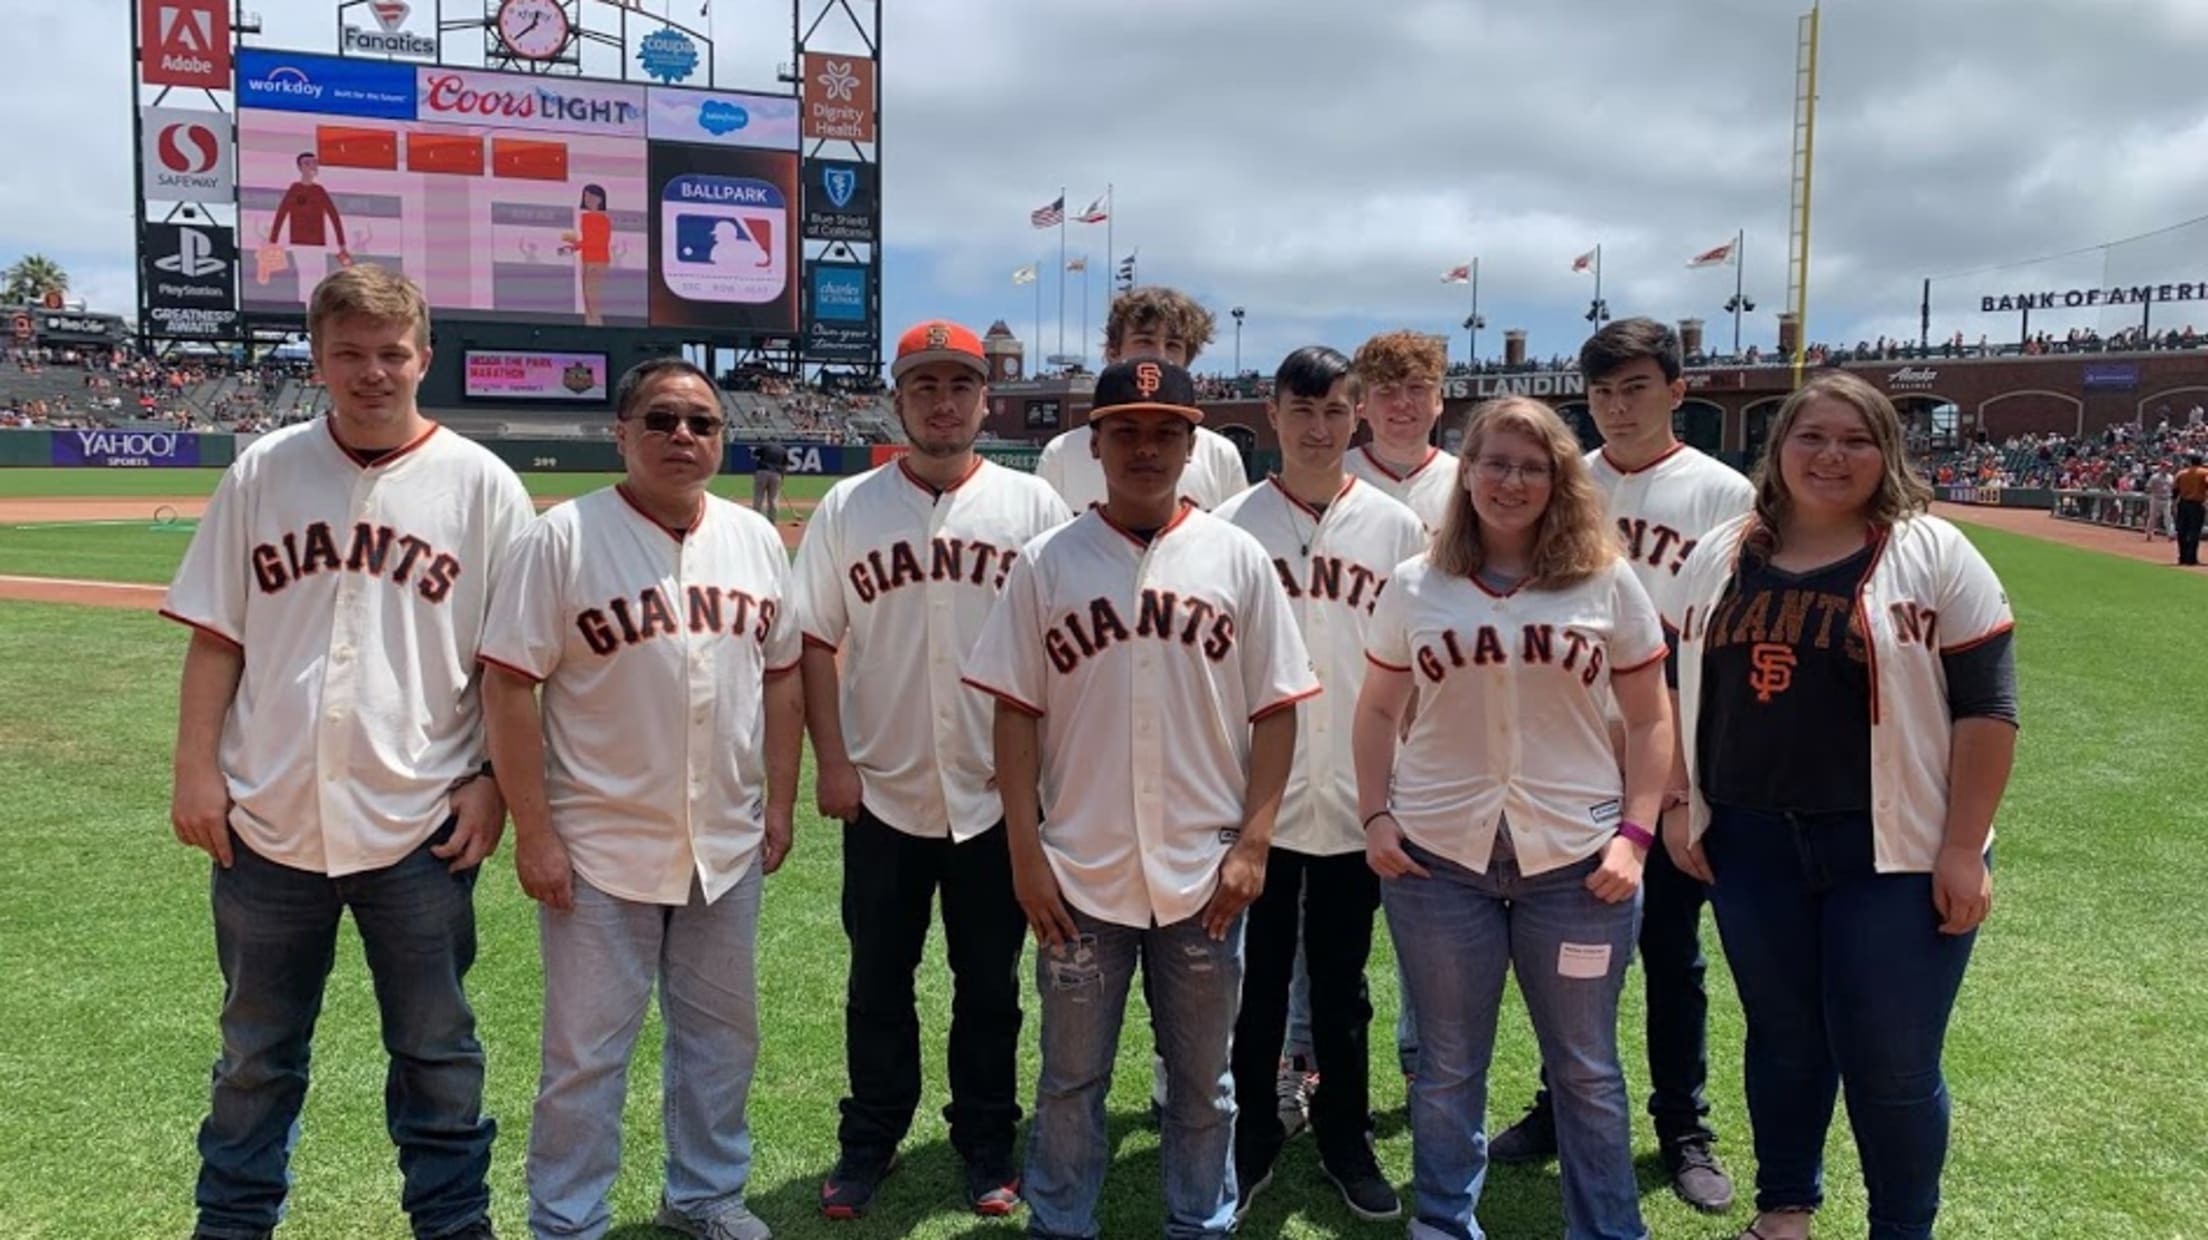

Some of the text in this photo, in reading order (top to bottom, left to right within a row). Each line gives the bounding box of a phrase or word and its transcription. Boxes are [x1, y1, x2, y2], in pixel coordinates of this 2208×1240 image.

[343, 28, 434, 54] Fanatics
[161, 55, 213, 74] Adobe
[249, 78, 324, 98] workday
[427, 75, 630, 124] Coors LIGHT
[813, 103, 864, 124] Dignity
[816, 121, 861, 137] Health
[158, 173, 219, 188] SAFEWAY
[681, 182, 768, 202] BALLPARK
[811, 213, 834, 225] Blue
[807, 224, 819, 235] of
[158, 283, 224, 298] PlayStation
[1981, 282, 2208, 312] BANK OF AMERI
[151, 307, 237, 323] GREATNESS
[165, 320, 219, 333] AWAITS
[470, 366, 525, 379] MARATHON
[526, 358, 553, 369] PARK
[1887, 366, 1938, 381] Alaska
[1477, 374, 1585, 398] LANDIN
[78, 431, 177, 457] YAHOO!
[107, 457, 149, 466] SPORTS
[252, 521, 462, 604] GIANTS
[1271, 555, 1389, 617] ANT
[575, 586, 777, 657] GIANTS
[1044, 588, 1234, 675] GIANTS
[1416, 624, 1604, 687] GIANTS
